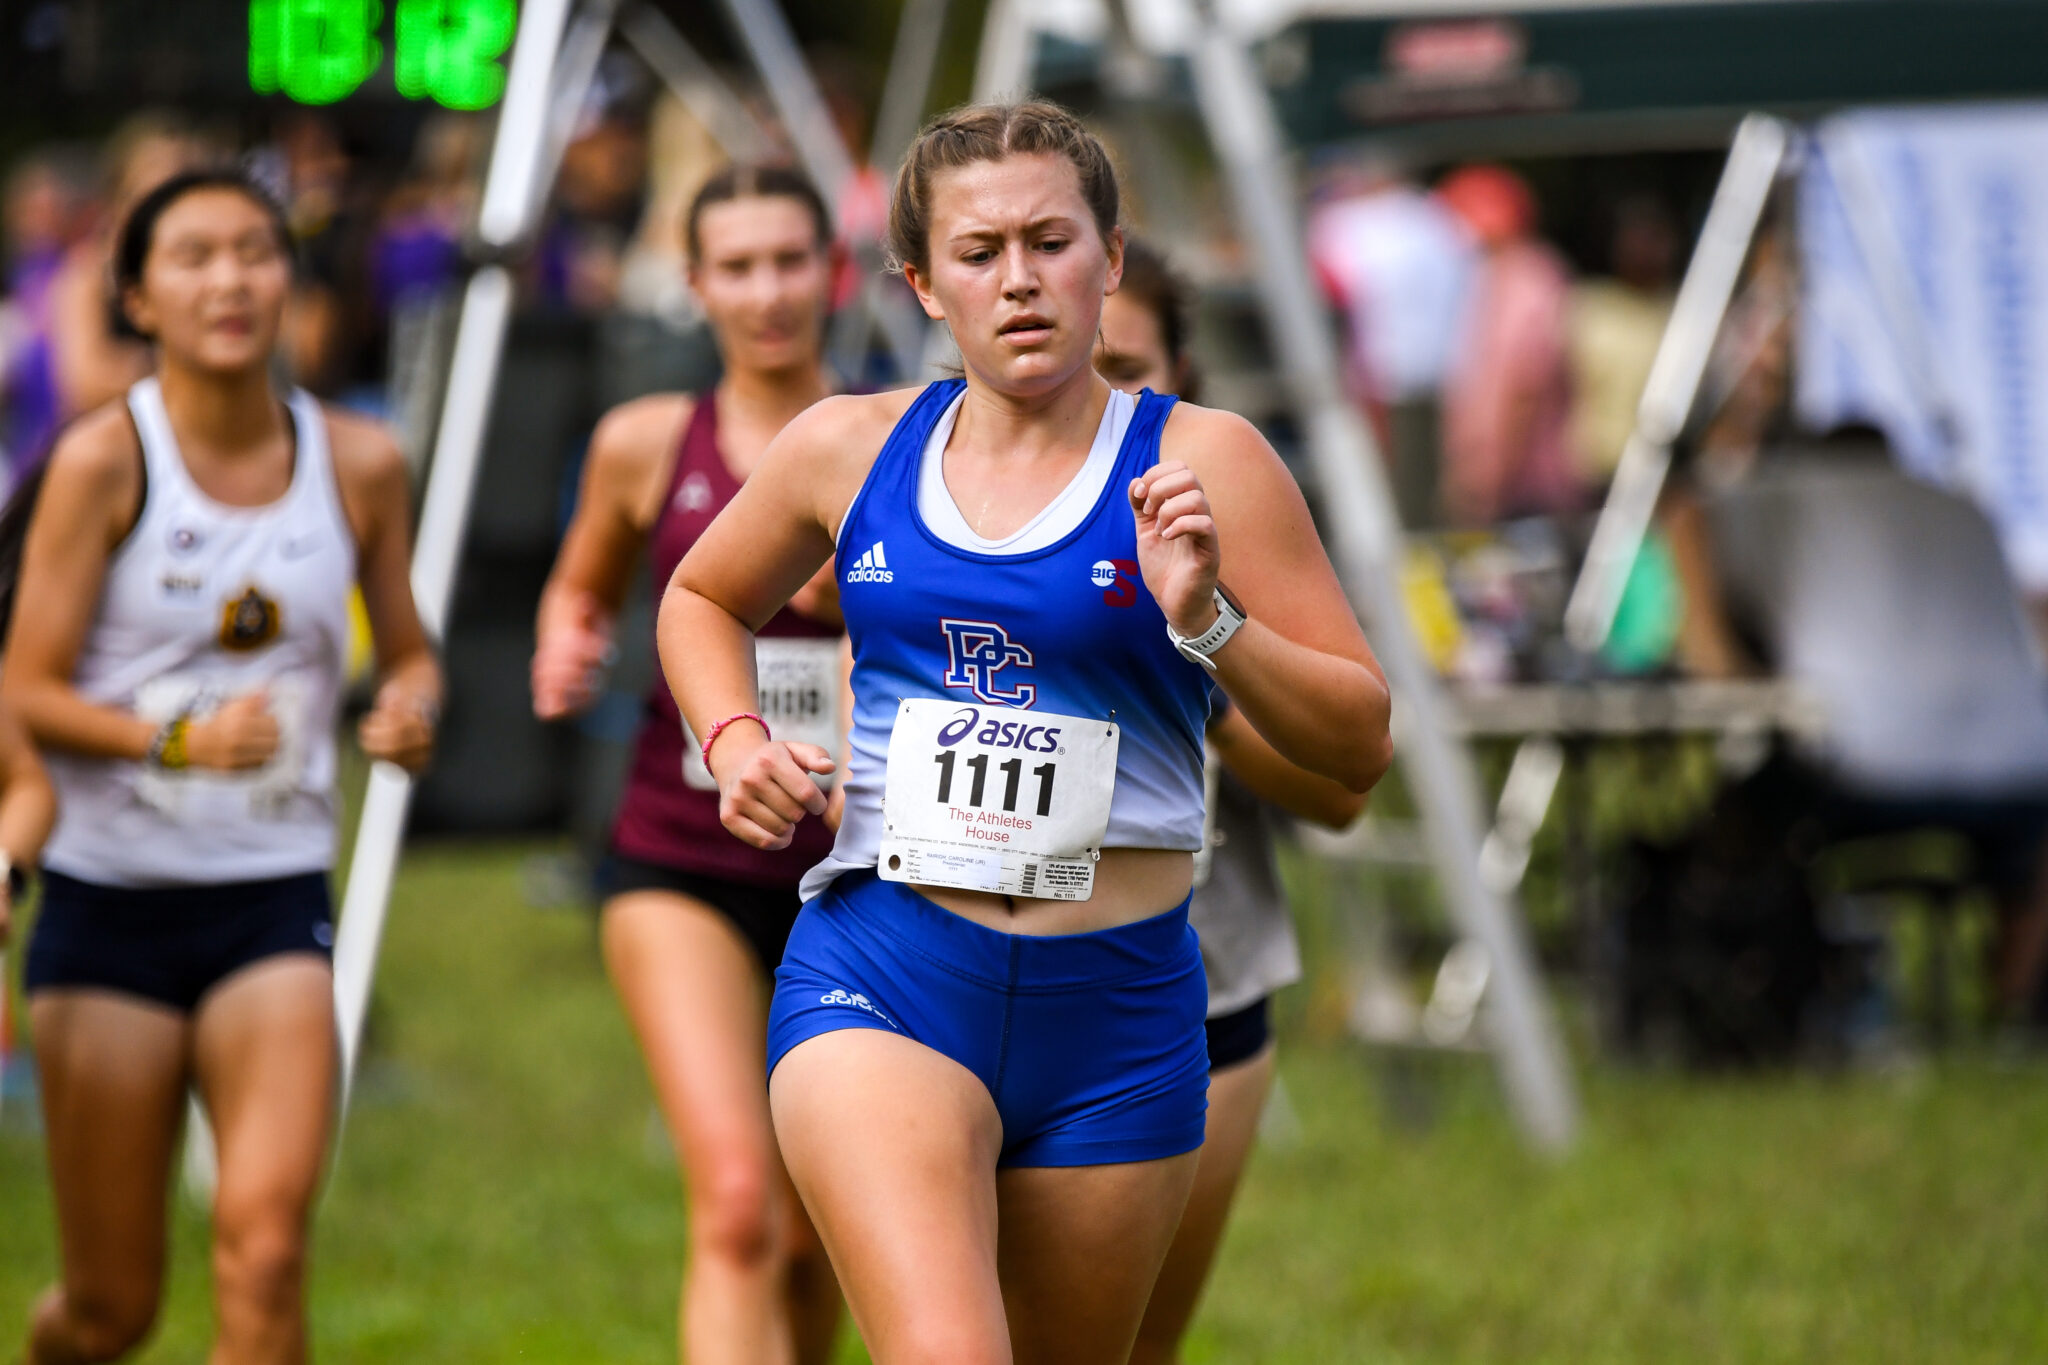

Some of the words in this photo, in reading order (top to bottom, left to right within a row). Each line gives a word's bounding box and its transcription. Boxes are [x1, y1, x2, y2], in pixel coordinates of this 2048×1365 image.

[847, 566, 894, 584] adidas
[1091, 567, 1117, 580] BIG
[940, 617, 1036, 710] PC
[934, 749, 1057, 817] 1111
[948, 807, 974, 822] The
[976, 811, 1032, 830] Athletes
[965, 825, 1010, 843] House
